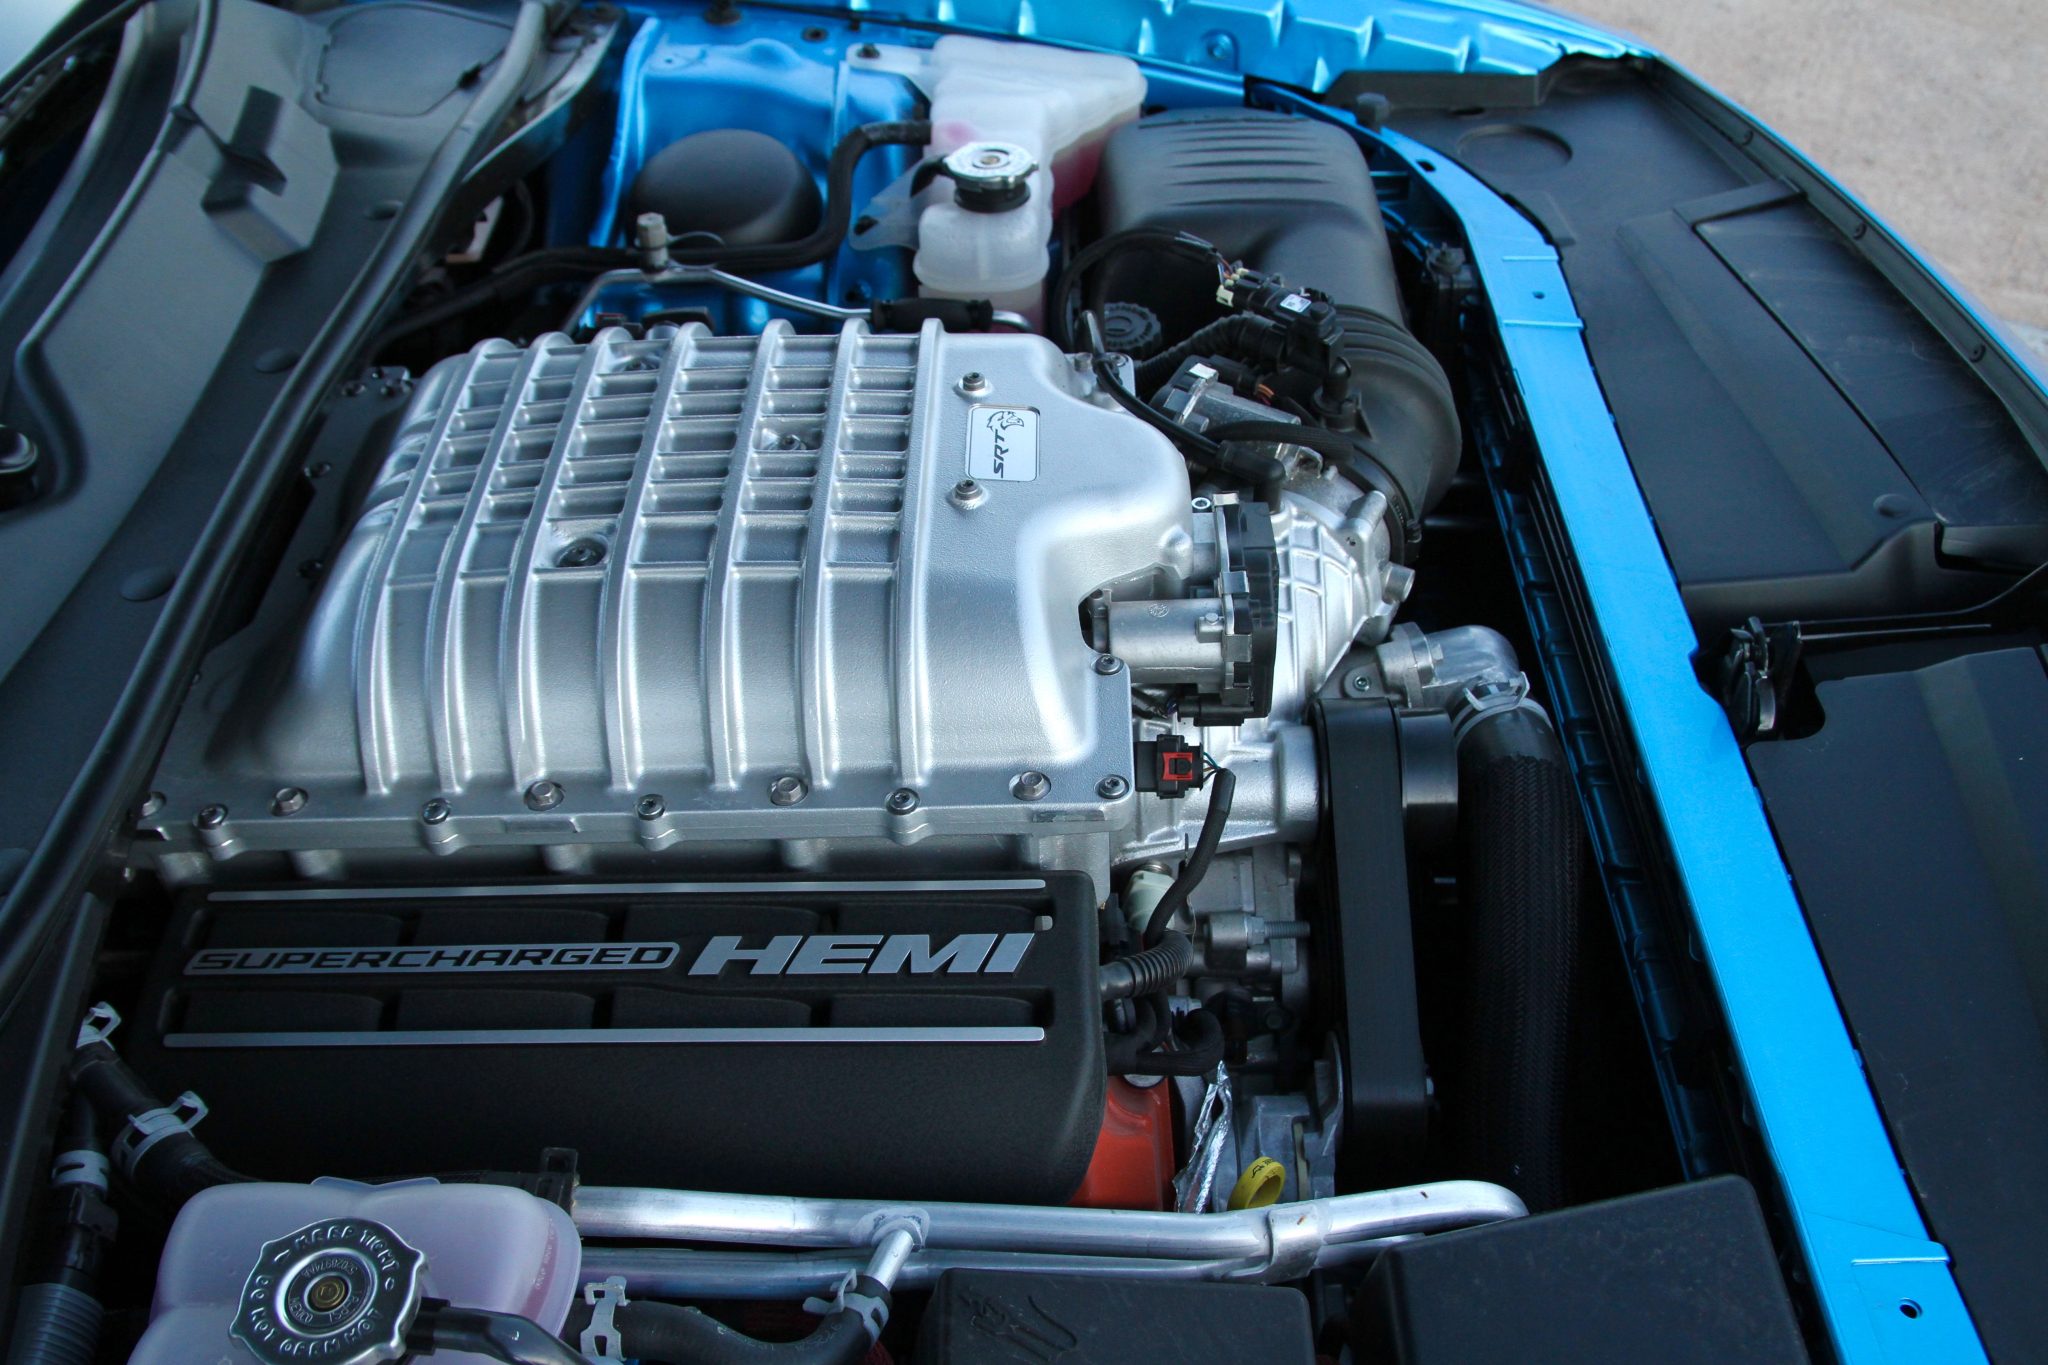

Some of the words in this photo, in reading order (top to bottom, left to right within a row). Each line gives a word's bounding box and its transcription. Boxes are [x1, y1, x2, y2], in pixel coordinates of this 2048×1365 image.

[993, 428, 1009, 479] SRT
[193, 946, 672, 970] SUPERCHARGED
[688, 933, 1035, 975] HEMI
[295, 1225, 355, 1249] KEEP
[359, 1229, 399, 1271] TIGHT
[251, 1306, 276, 1341] NOT
[279, 1337, 341, 1357] OPEN
